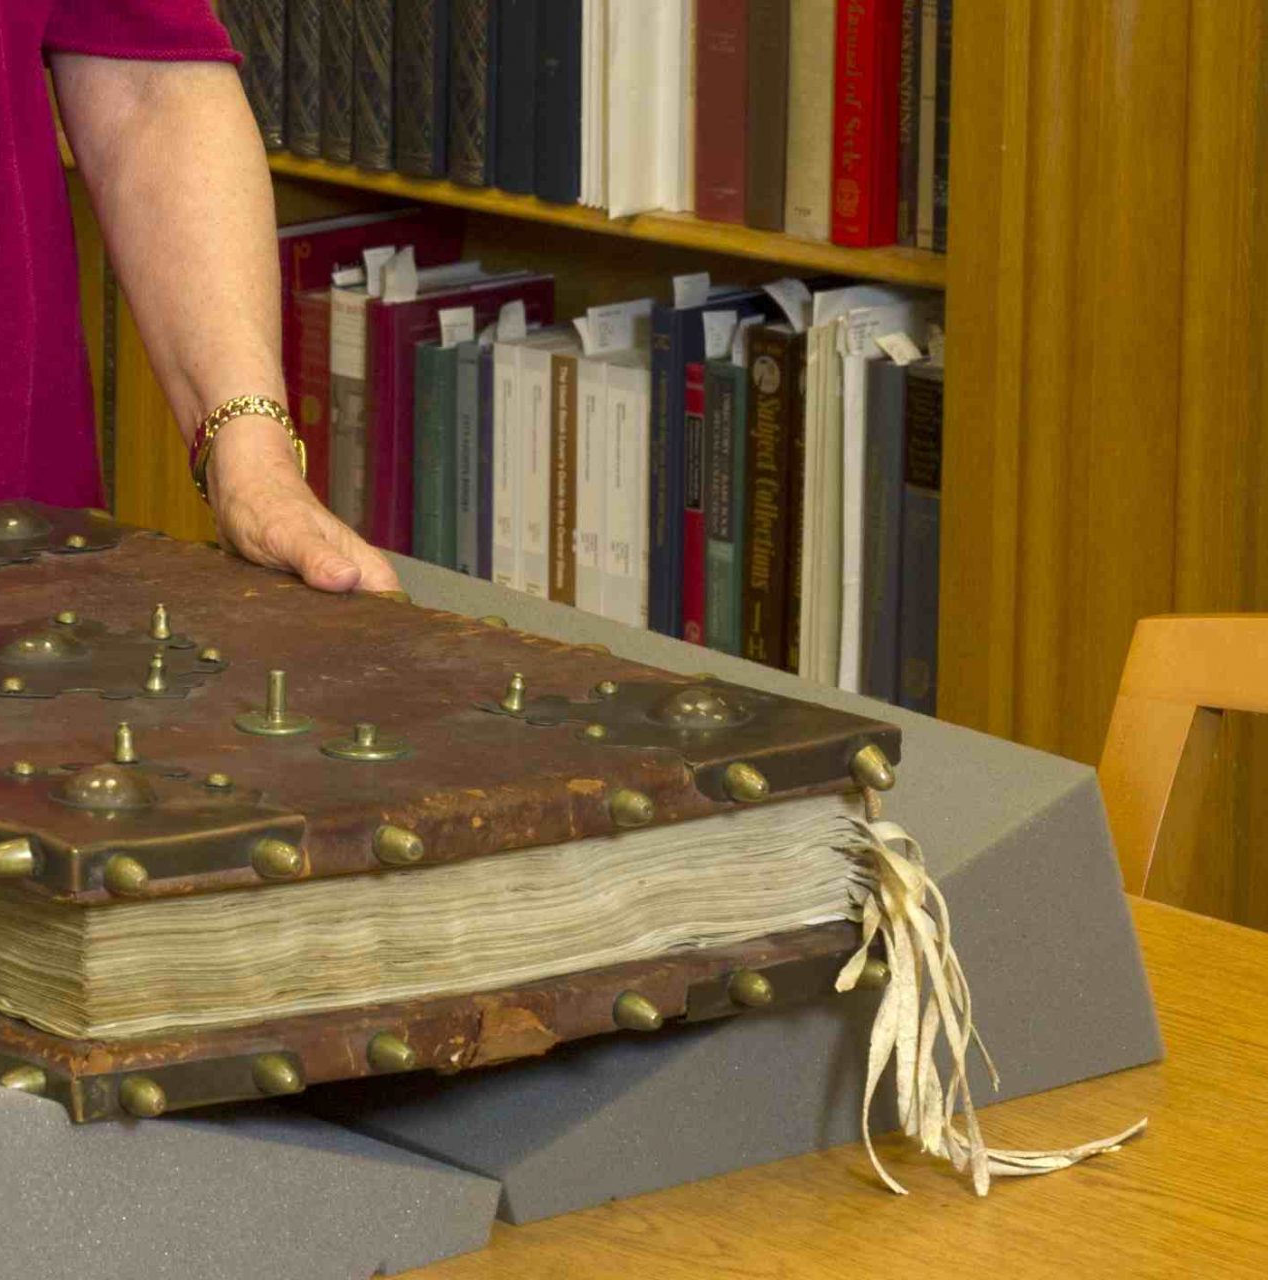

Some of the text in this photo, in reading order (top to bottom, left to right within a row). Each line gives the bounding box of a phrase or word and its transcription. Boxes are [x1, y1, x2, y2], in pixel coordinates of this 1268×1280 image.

[842, 117, 862, 174] Style
[560, 366, 569, 383] The
[559, 384, 569, 408] Used
[559, 409, 568, 434] Book
[558, 435, 568, 469] Lover's
[557, 470, 567, 497] Guide
[751, 393, 781, 593] Subject Collections
